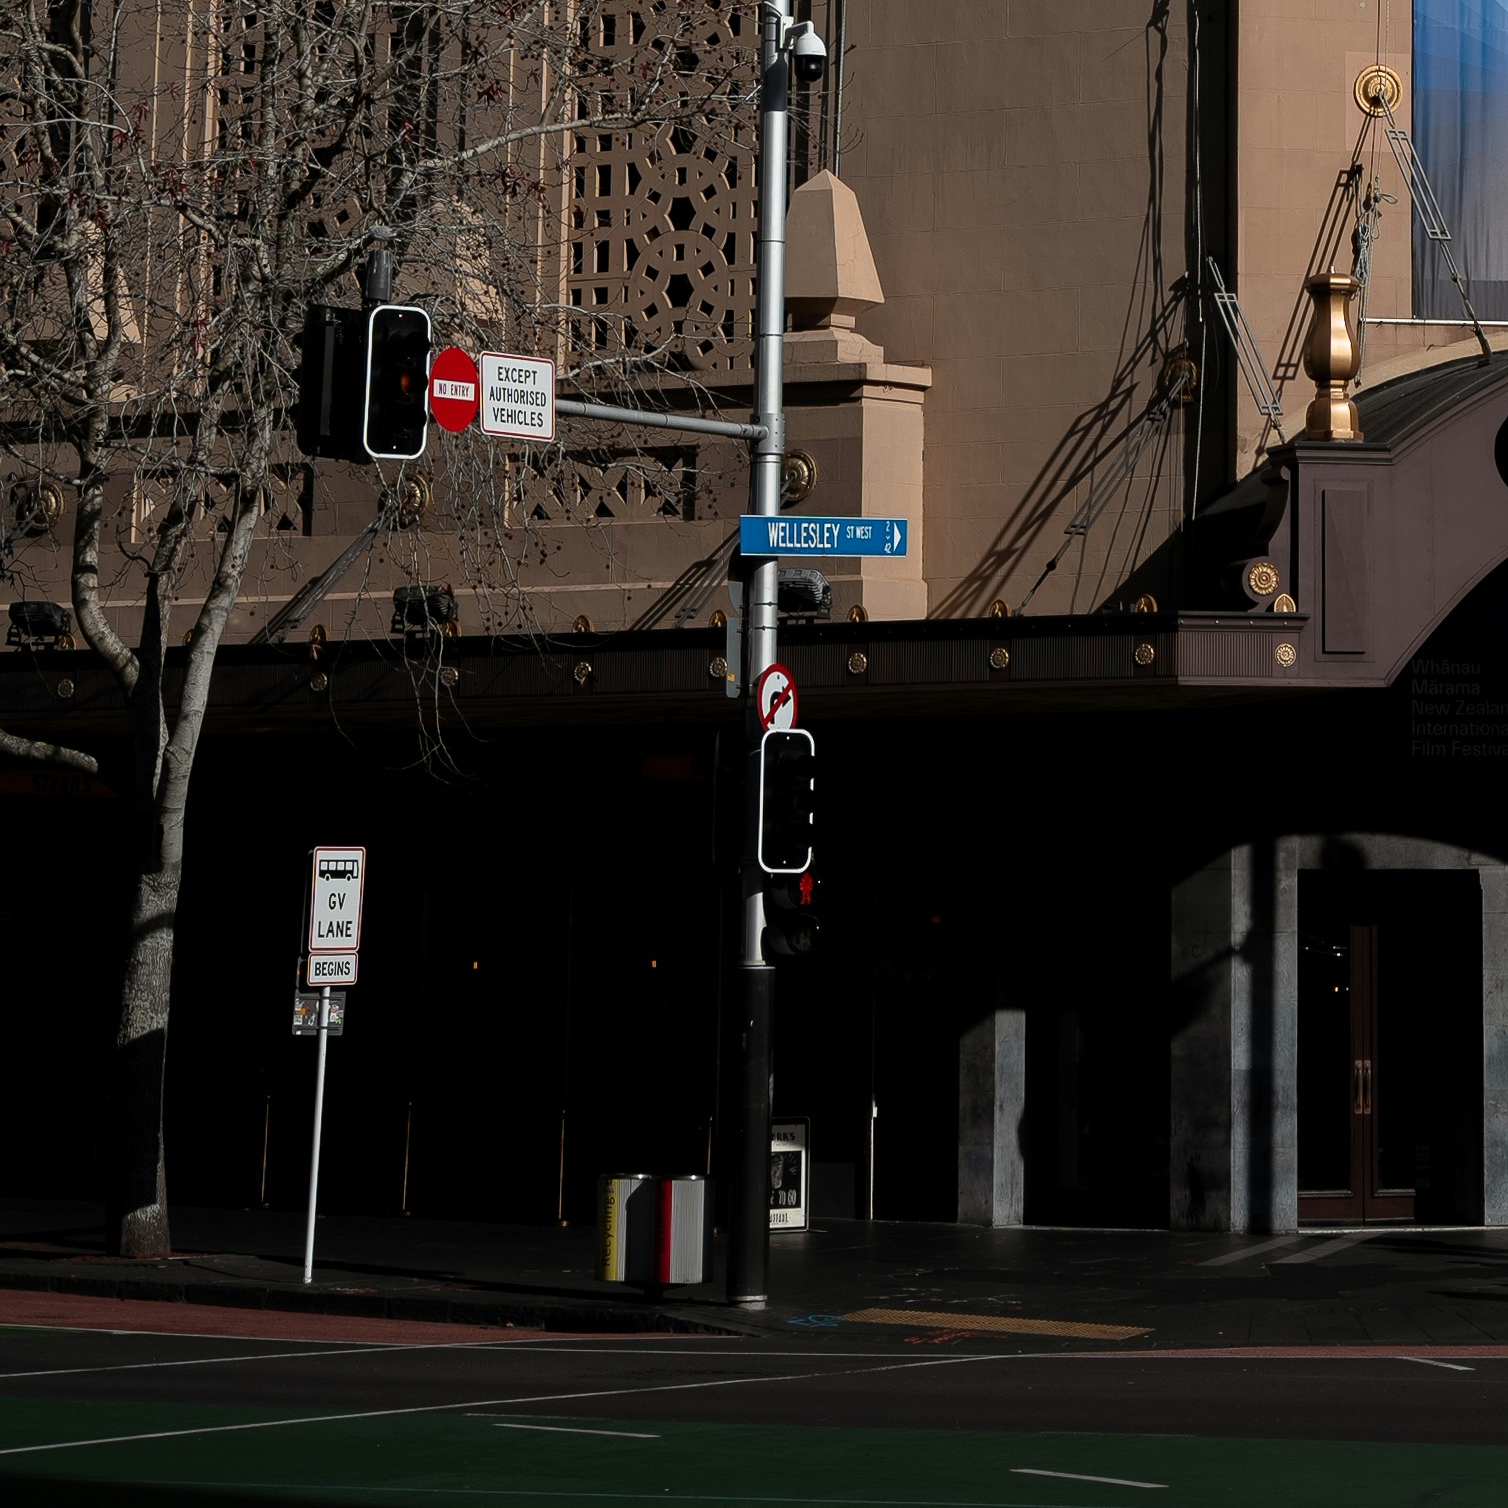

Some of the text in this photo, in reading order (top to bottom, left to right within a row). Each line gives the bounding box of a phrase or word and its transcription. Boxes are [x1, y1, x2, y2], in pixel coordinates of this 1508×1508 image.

[497, 366, 538, 386] EXCEPT
[438, 382, 470, 397] NO ENTRY
[489, 385, 547, 407] AUTHORISED
[492, 406, 544, 428] VEHICLES
[768, 522, 872, 548] WELLESLEY ST WEST
[885, 521, 891, 532] 2
[1411, 658, 1481, 675] Whānau
[1411, 678, 1481, 695] Mārama
[1411, 699, 1451, 716] New
[1411, 740, 1447, 757] Film
[328, 892, 346, 911] GV
[317, 920, 353, 938] LANE
[314, 960, 351, 977] BEGINS
[601, 1196, 616, 1267] Recycling
